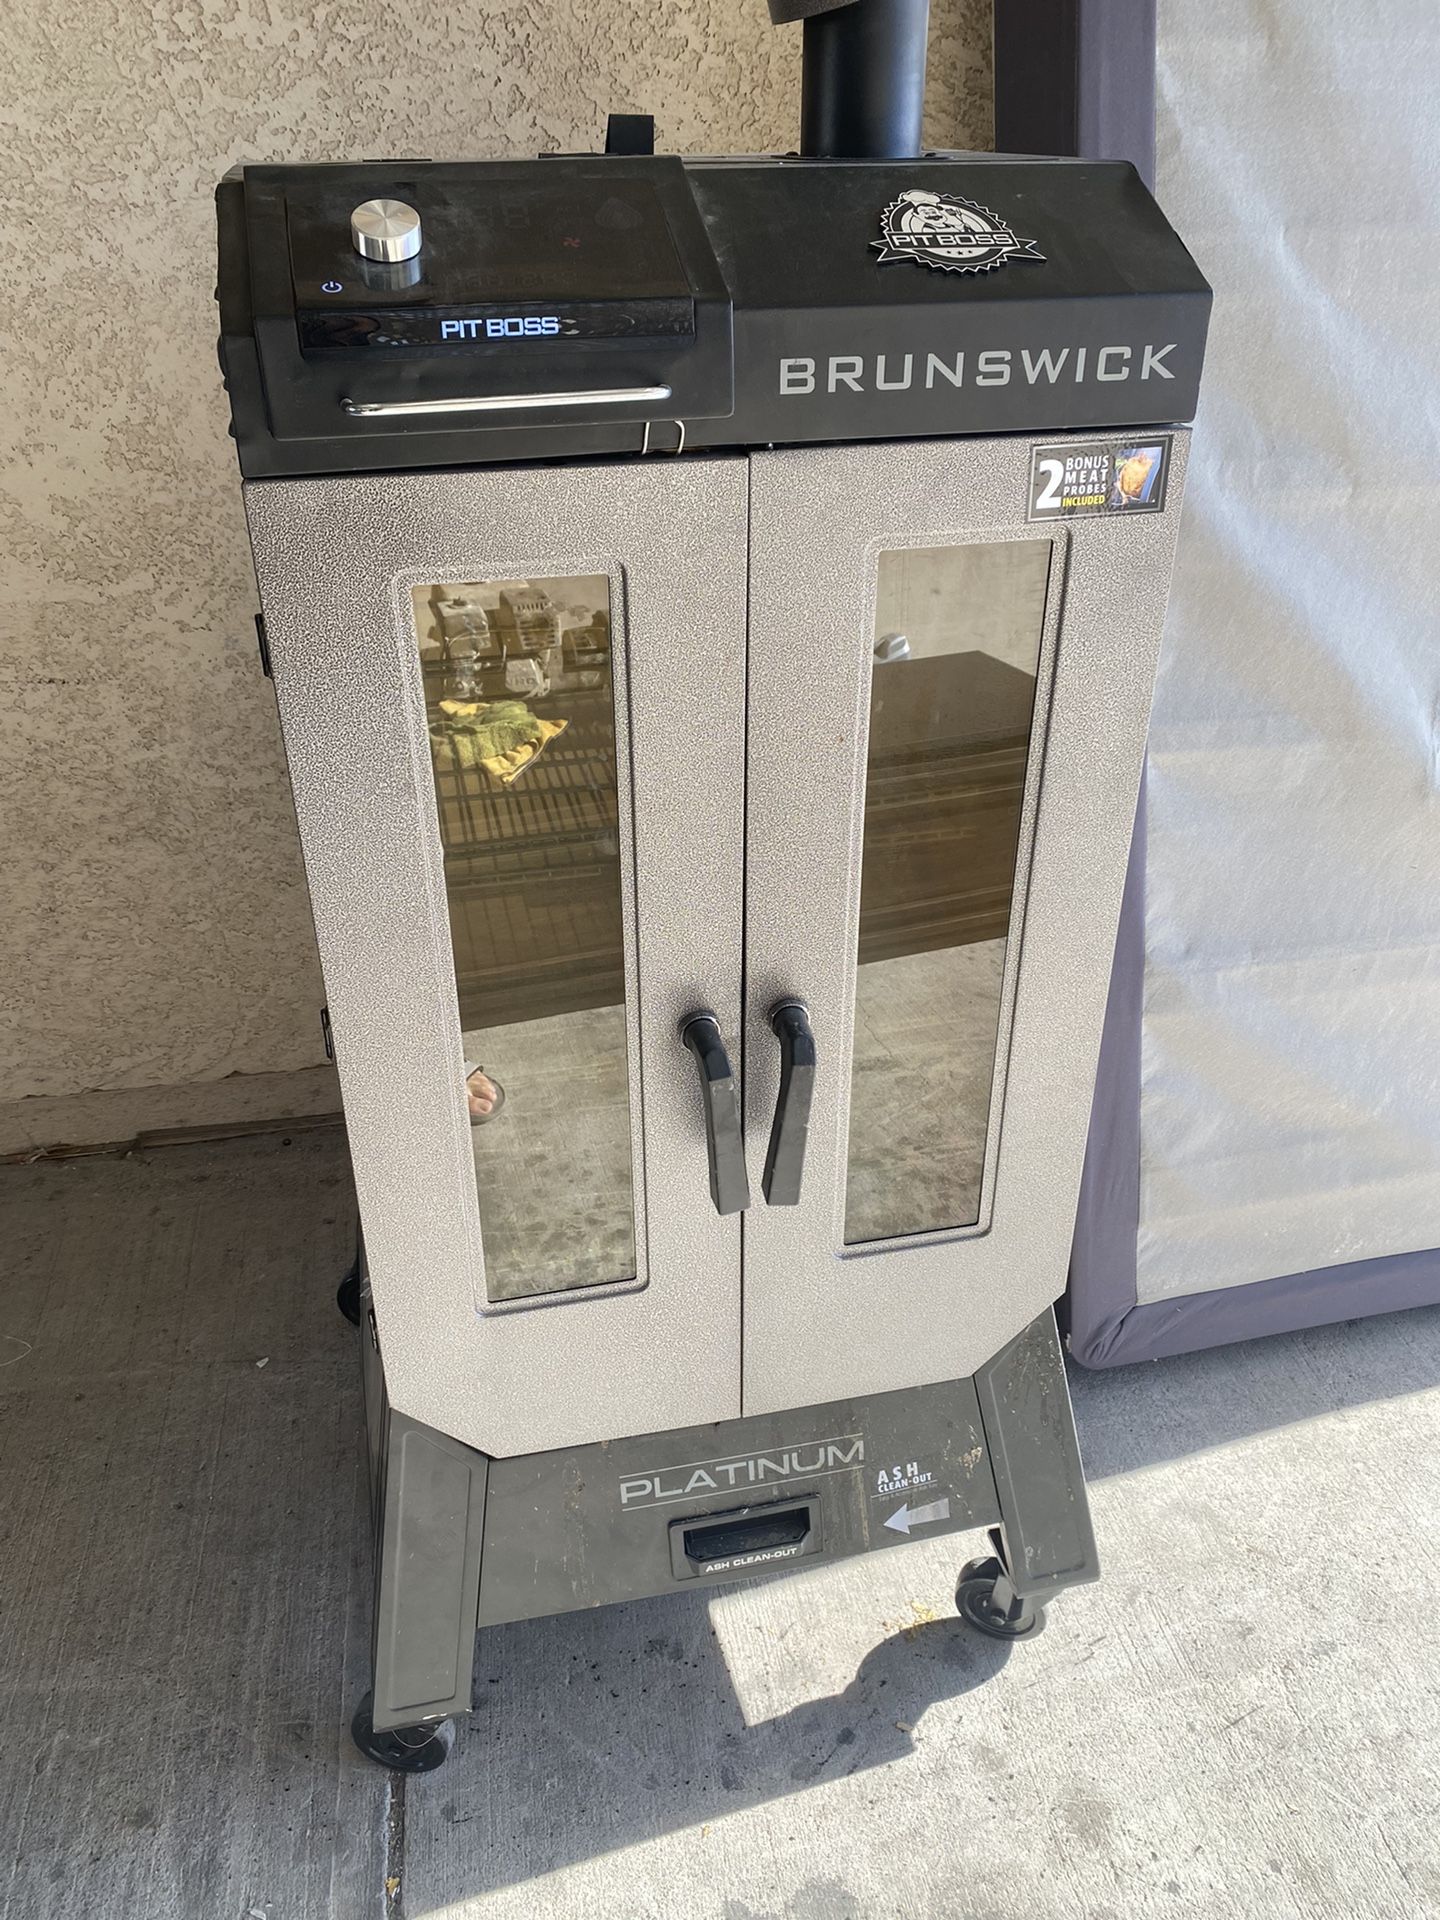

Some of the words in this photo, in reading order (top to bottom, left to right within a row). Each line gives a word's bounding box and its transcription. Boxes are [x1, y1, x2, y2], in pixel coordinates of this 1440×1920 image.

[891, 234, 932, 247] PIT
[936, 233, 1013, 247] BOSS
[441, 319, 482, 339] PIT
[486, 316, 559, 337] BOSS
[779, 343, 1177, 395] BRUNSWICK
[1066, 455, 1109, 471] BONUS
[1036, 459, 1065, 510] 2
[1065, 469, 1108, 484] MEAT
[1063, 483, 1107, 496] PROBES
[1062, 495, 1106, 508] INCLUDED
[620, 1440, 865, 1504] PLATINUM
[877, 1461, 919, 1485] ASH
[878, 1472, 932, 1493] CLEAN-OUT
[705, 1561, 730, 1573] ASH
[733, 1548, 798, 1567] CLEAN-OUT
